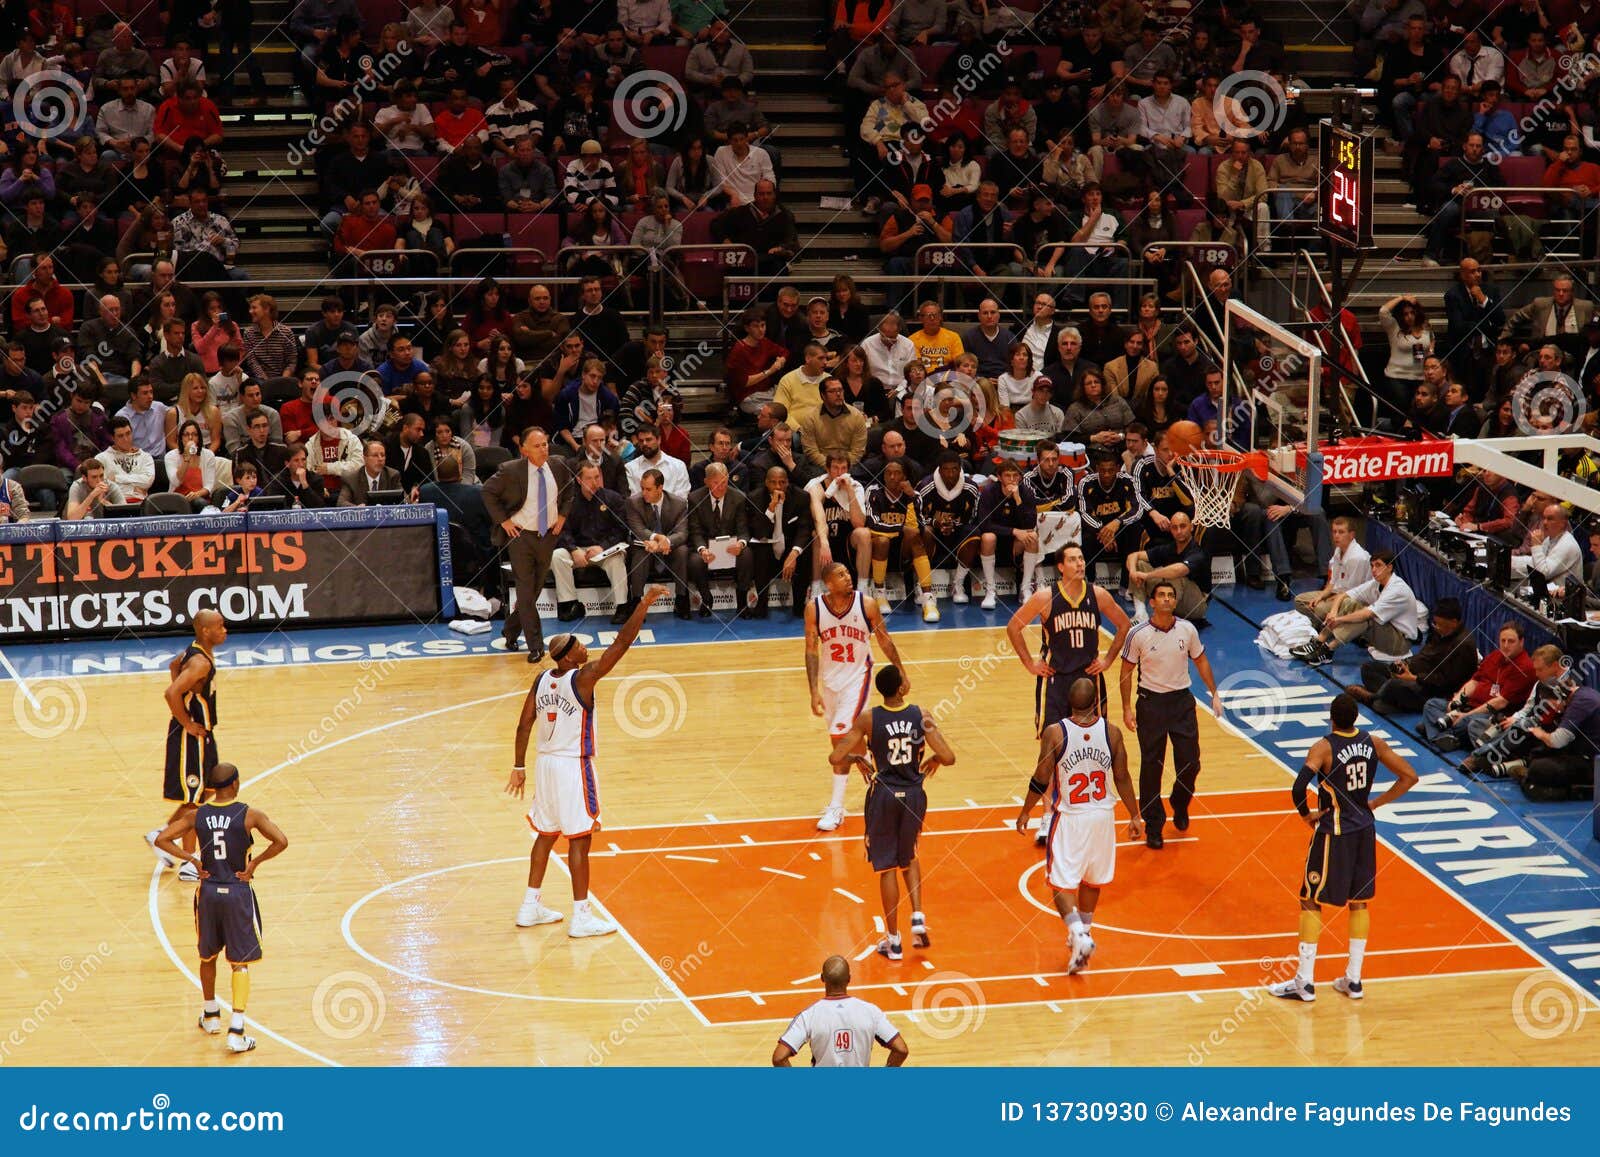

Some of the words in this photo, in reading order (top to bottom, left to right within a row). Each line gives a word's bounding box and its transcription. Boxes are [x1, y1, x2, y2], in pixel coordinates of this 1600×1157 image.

[1332, 169, 1357, 226] 24
[725, 251, 747, 265] 87
[932, 251, 956, 265] 88
[1206, 249, 1229, 263] 89
[24, 530, 308, 585] TICKETS
[0, 582, 310, 635] NICKS.COM
[1053, 610, 1097, 633] INDIANA
[840, 624, 867, 643] YORK
[1068, 629, 1085, 649] 10
[829, 643, 856, 664] 21
[546, 712, 558, 742] 7
[885, 719, 913, 737] RUSH
[887, 737, 914, 766] 25
[1060, 746, 1113, 774] RICHARDSON
[1337, 743, 1374, 765] GRANGER
[1068, 769, 1107, 805] 23
[1345, 761, 1368, 792] 33
[205, 814, 231, 830] FORD
[212, 830, 228, 861] 5
[835, 1030, 851, 1050] 49
